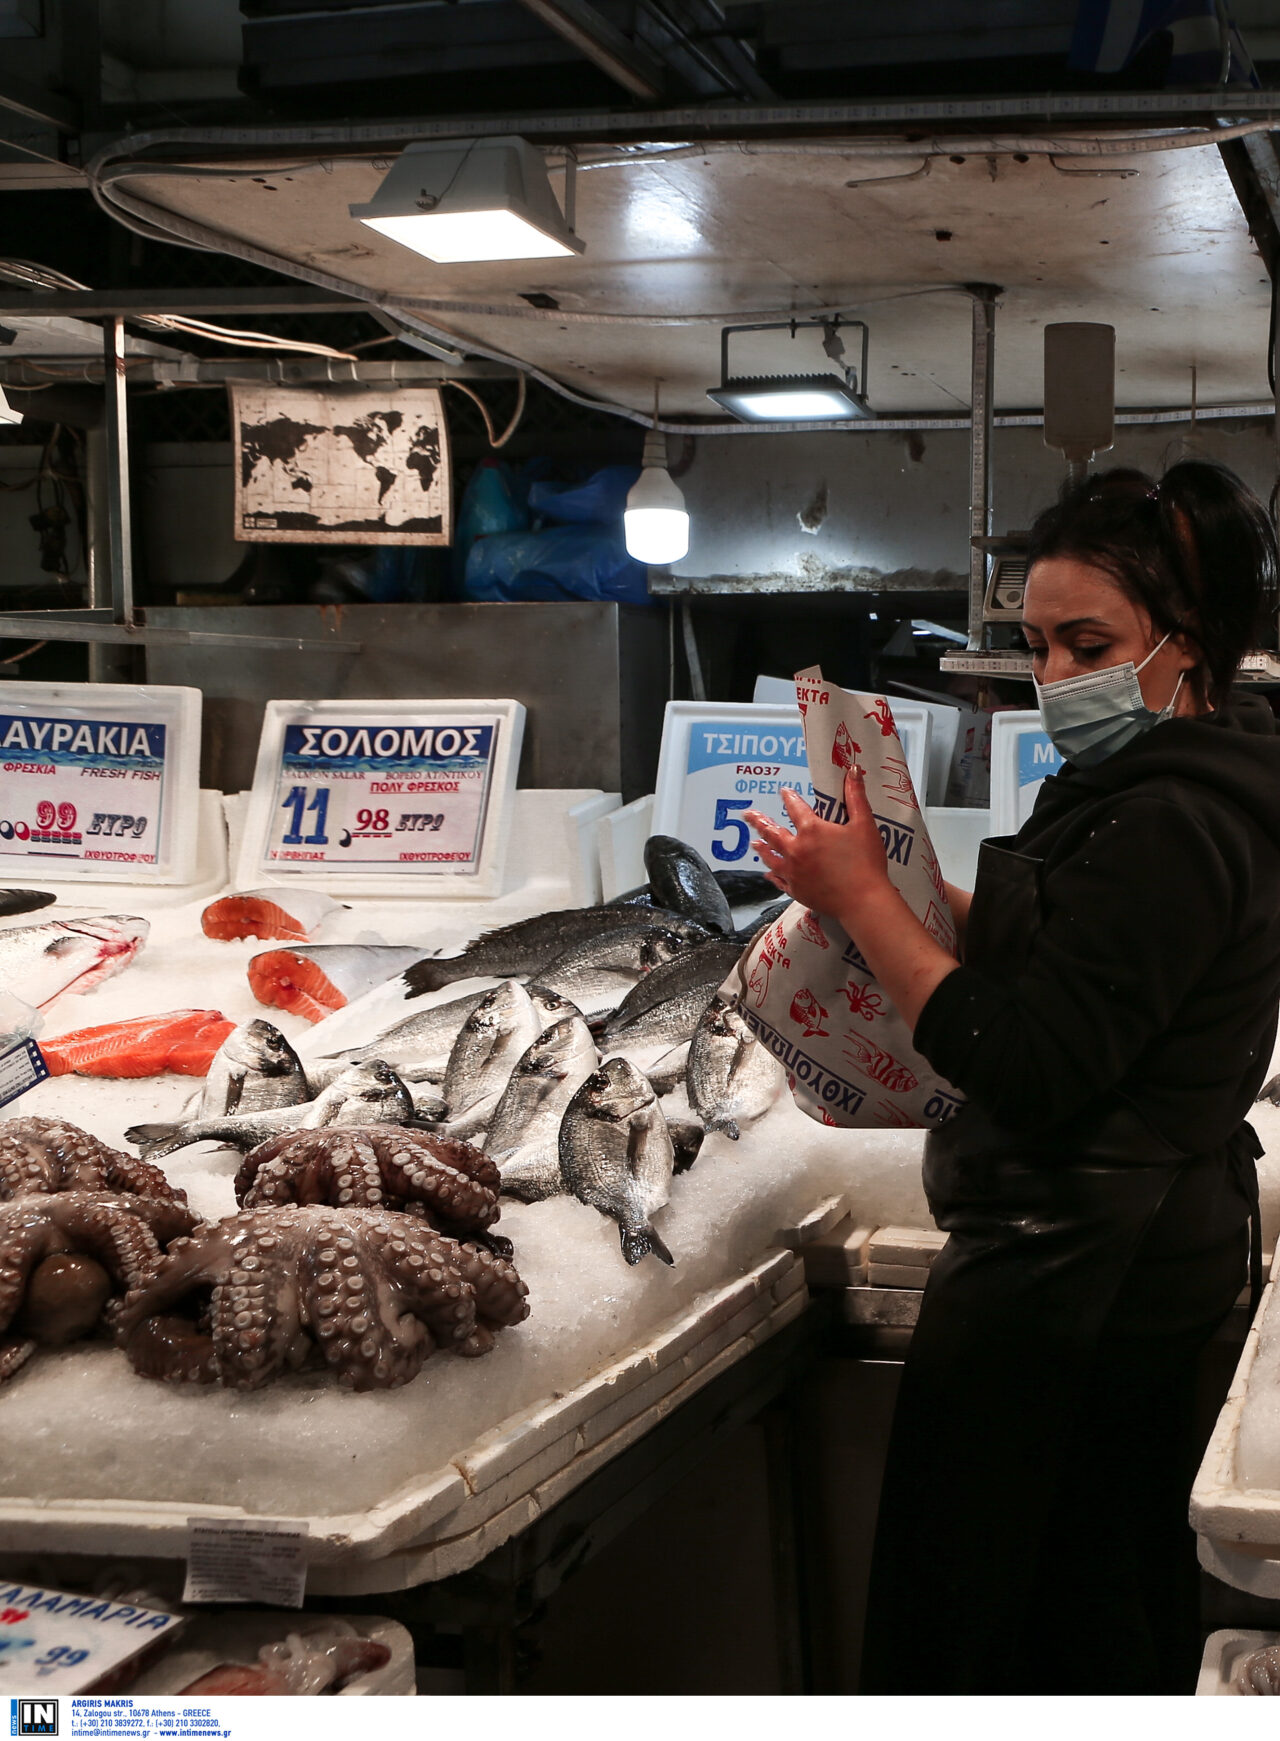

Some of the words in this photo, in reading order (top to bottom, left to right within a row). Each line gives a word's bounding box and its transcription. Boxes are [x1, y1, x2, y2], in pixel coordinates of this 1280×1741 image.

[796, 686, 830, 705] ΕΚΤΑ
[0, 720, 151, 756] ΑΥΡΑΚΙΑ
[299, 727, 482, 757] ΣΟΛΟΜΟΣ
[703, 732, 808, 757] ΤΣΙΠΟΥΡ
[3, 763, 56, 775] ΦΡΕΣΚΙΑ
[80, 767, 128, 779] FRESH
[132, 770, 162, 781] FISH
[736, 765, 781, 776] FAO37
[370, 782, 404, 793] ΠΟΛΥ
[406, 782, 460, 793] ΦΡΕΣΚΟΣ
[36, 800, 77, 832] 99
[86, 812, 148, 839] ΕΥΡΩ
[354, 808, 390, 832] 98
[395, 813, 445, 832] ΕΥΡΩ
[737, 1004, 867, 1116] ΙΧΘΥΟΠΩΛΕΙ
[0, 1583, 171, 1630] ΑΛΑΜΑΡΙΑ
[35, 1645, 91, 1668] 99
